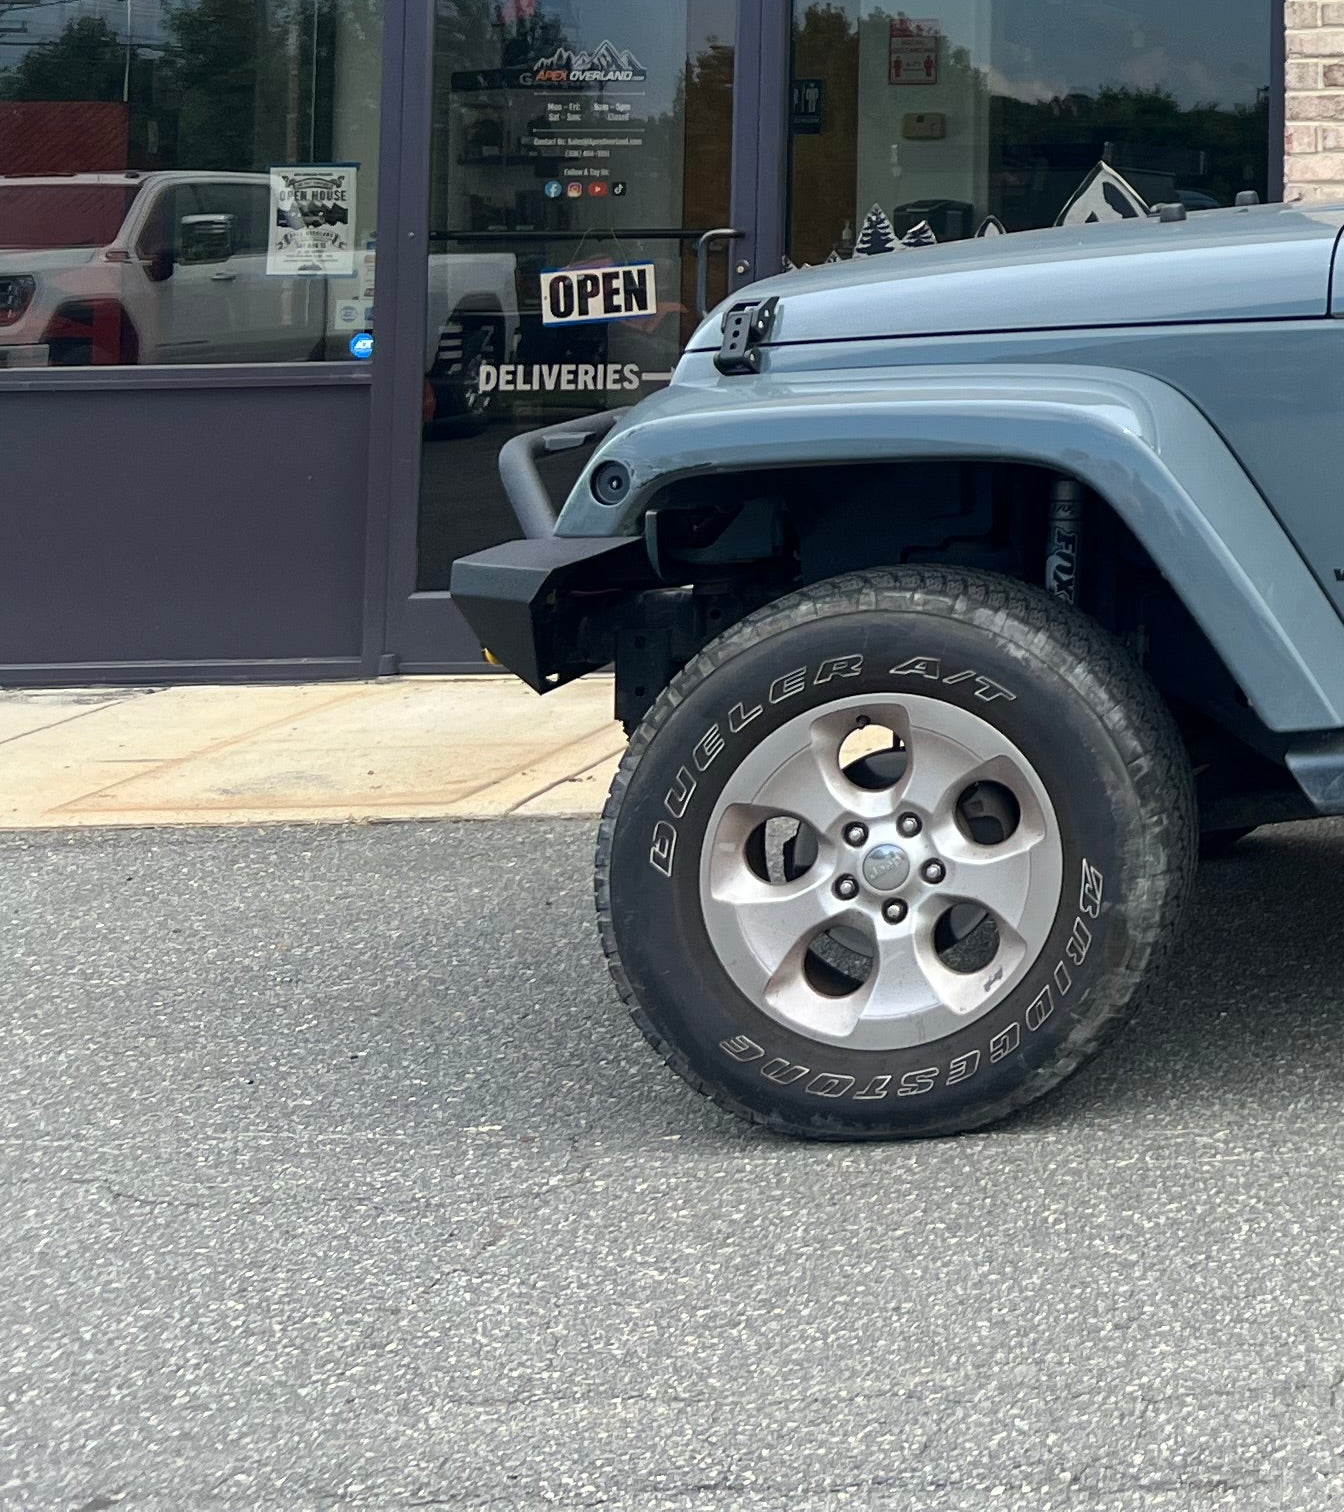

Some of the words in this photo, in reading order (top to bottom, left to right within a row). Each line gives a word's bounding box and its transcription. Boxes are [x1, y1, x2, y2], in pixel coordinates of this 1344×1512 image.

[536, 70, 569, 81] APEX
[279, 190, 307, 201] OPEN
[311, 190, 348, 201] HOUSE
[549, 268, 649, 319] OPEN
[479, 364, 641, 391] DELIVERIES
[649, 653, 865, 879] DUELER
[889, 655, 1017, 705] A/T
[719, 857, 1105, 1102] BRIDGESTONE
